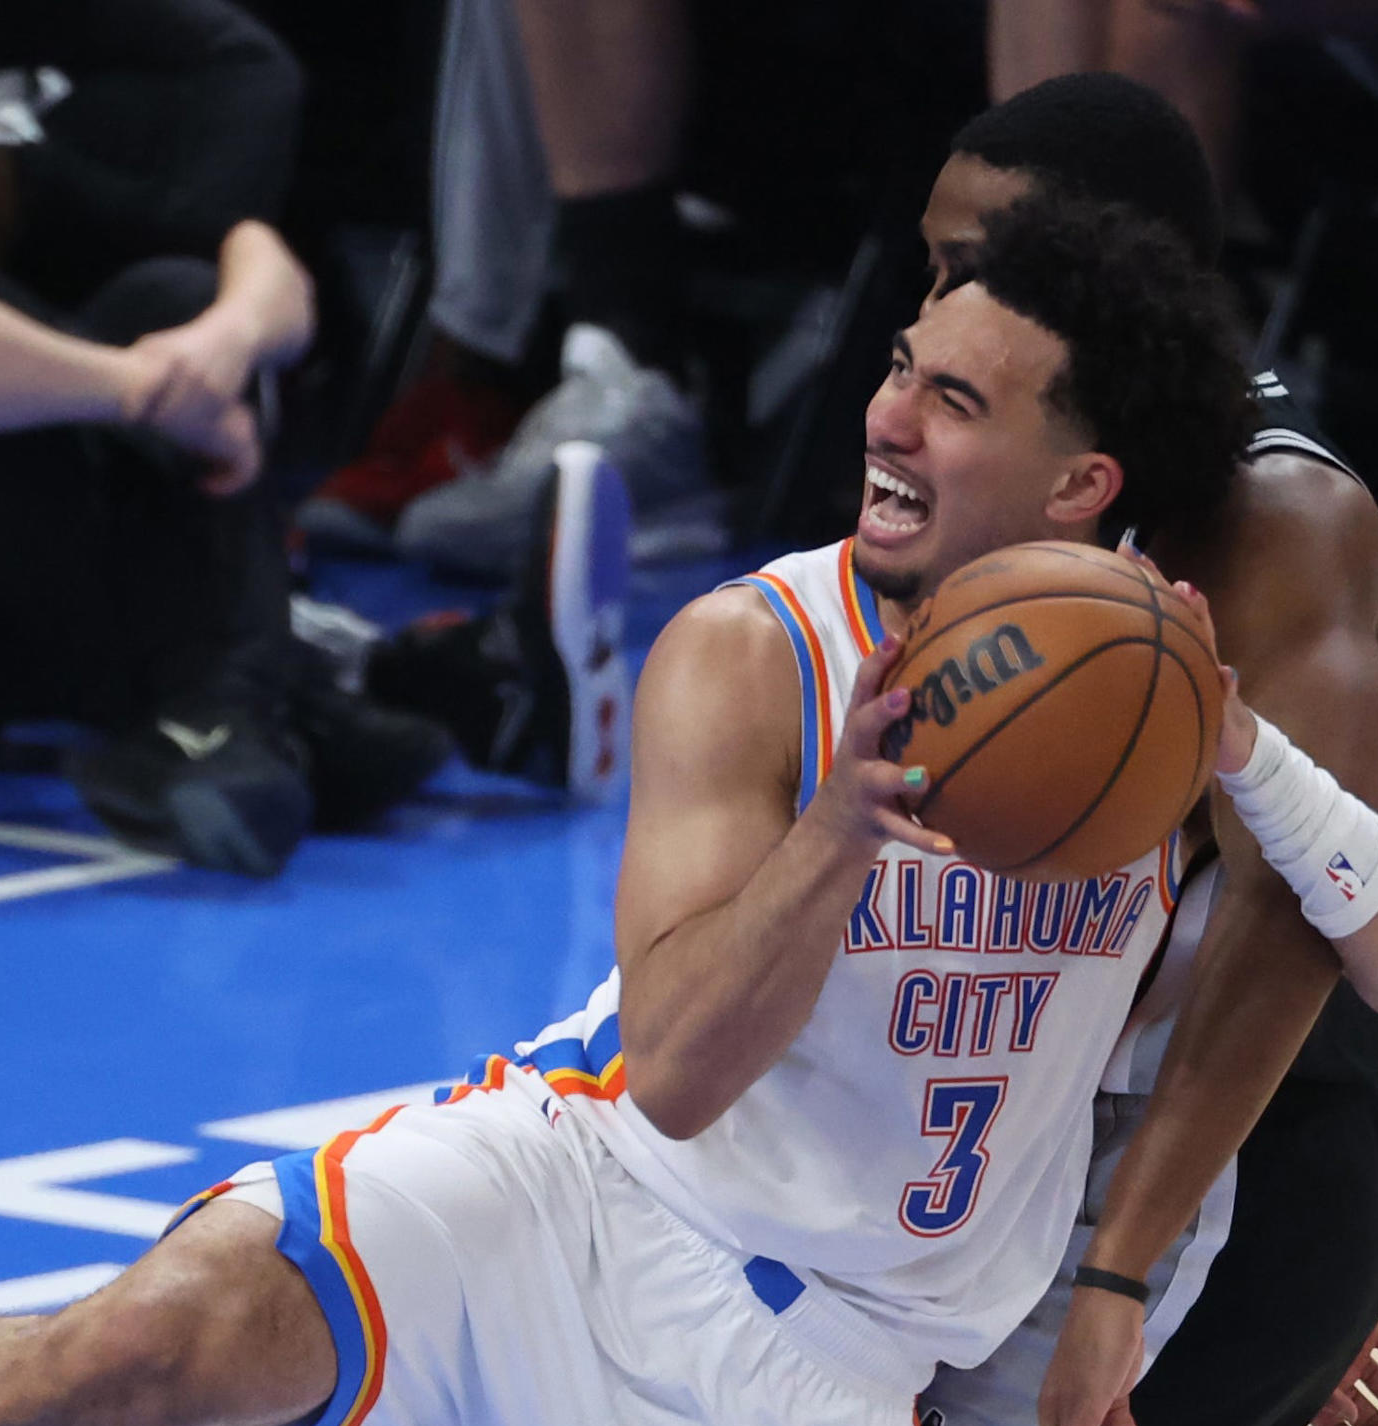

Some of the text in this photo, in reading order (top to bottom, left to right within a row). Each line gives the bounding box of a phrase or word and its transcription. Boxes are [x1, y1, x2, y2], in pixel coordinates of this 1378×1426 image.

[879, 622, 1046, 763] Wils
[844, 858, 1156, 960] KLAHOMA
[888, 968, 1061, 1058] CITY
[897, 1075, 1010, 1240] 3
